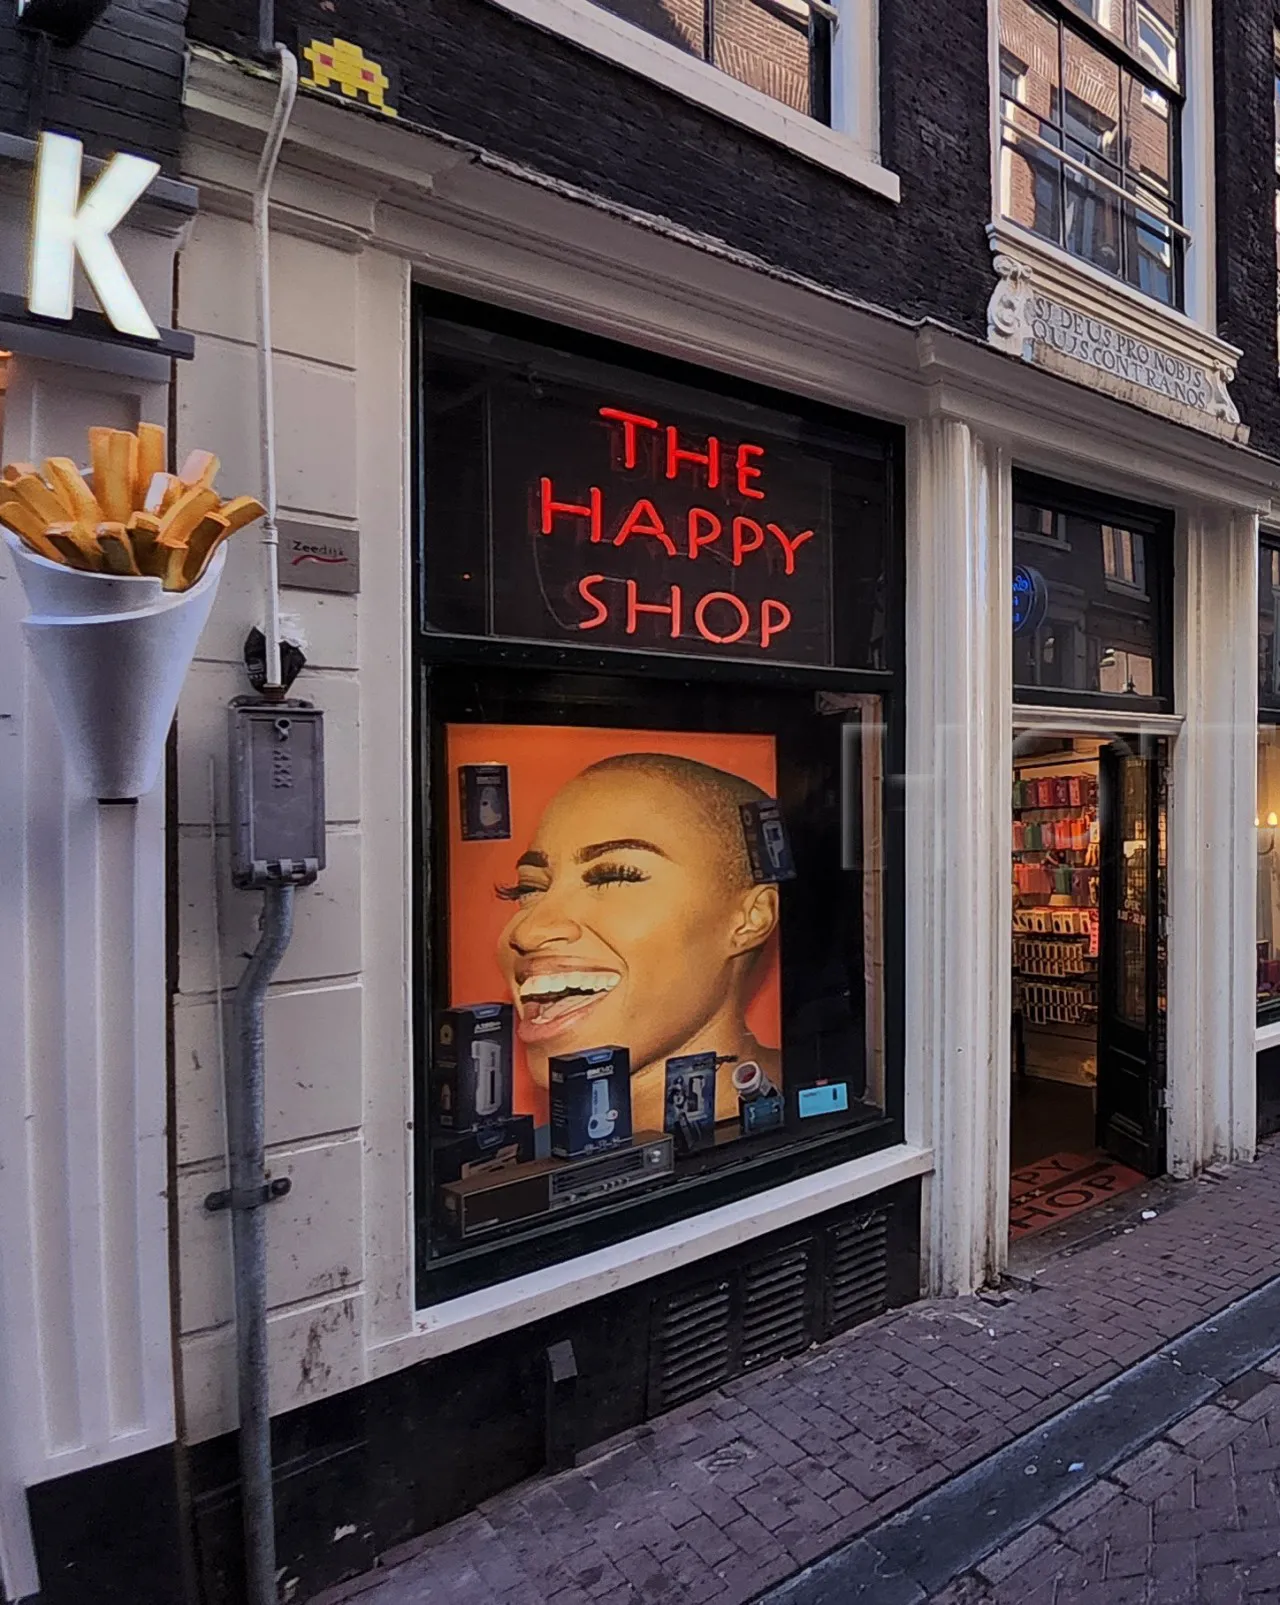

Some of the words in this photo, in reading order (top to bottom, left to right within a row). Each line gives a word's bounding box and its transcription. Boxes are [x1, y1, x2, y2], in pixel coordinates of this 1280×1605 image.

[28, 129, 162, 340] K
[1060, 308, 1112, 346] DEUS
[1117, 333, 1149, 362] PRO
[1091, 349, 1170, 395] CONTRA
[1174, 383, 1206, 409] NOS
[599, 407, 765, 499] THE
[540, 477, 814, 575] HAPPY
[578, 575, 792, 648] SHOP
